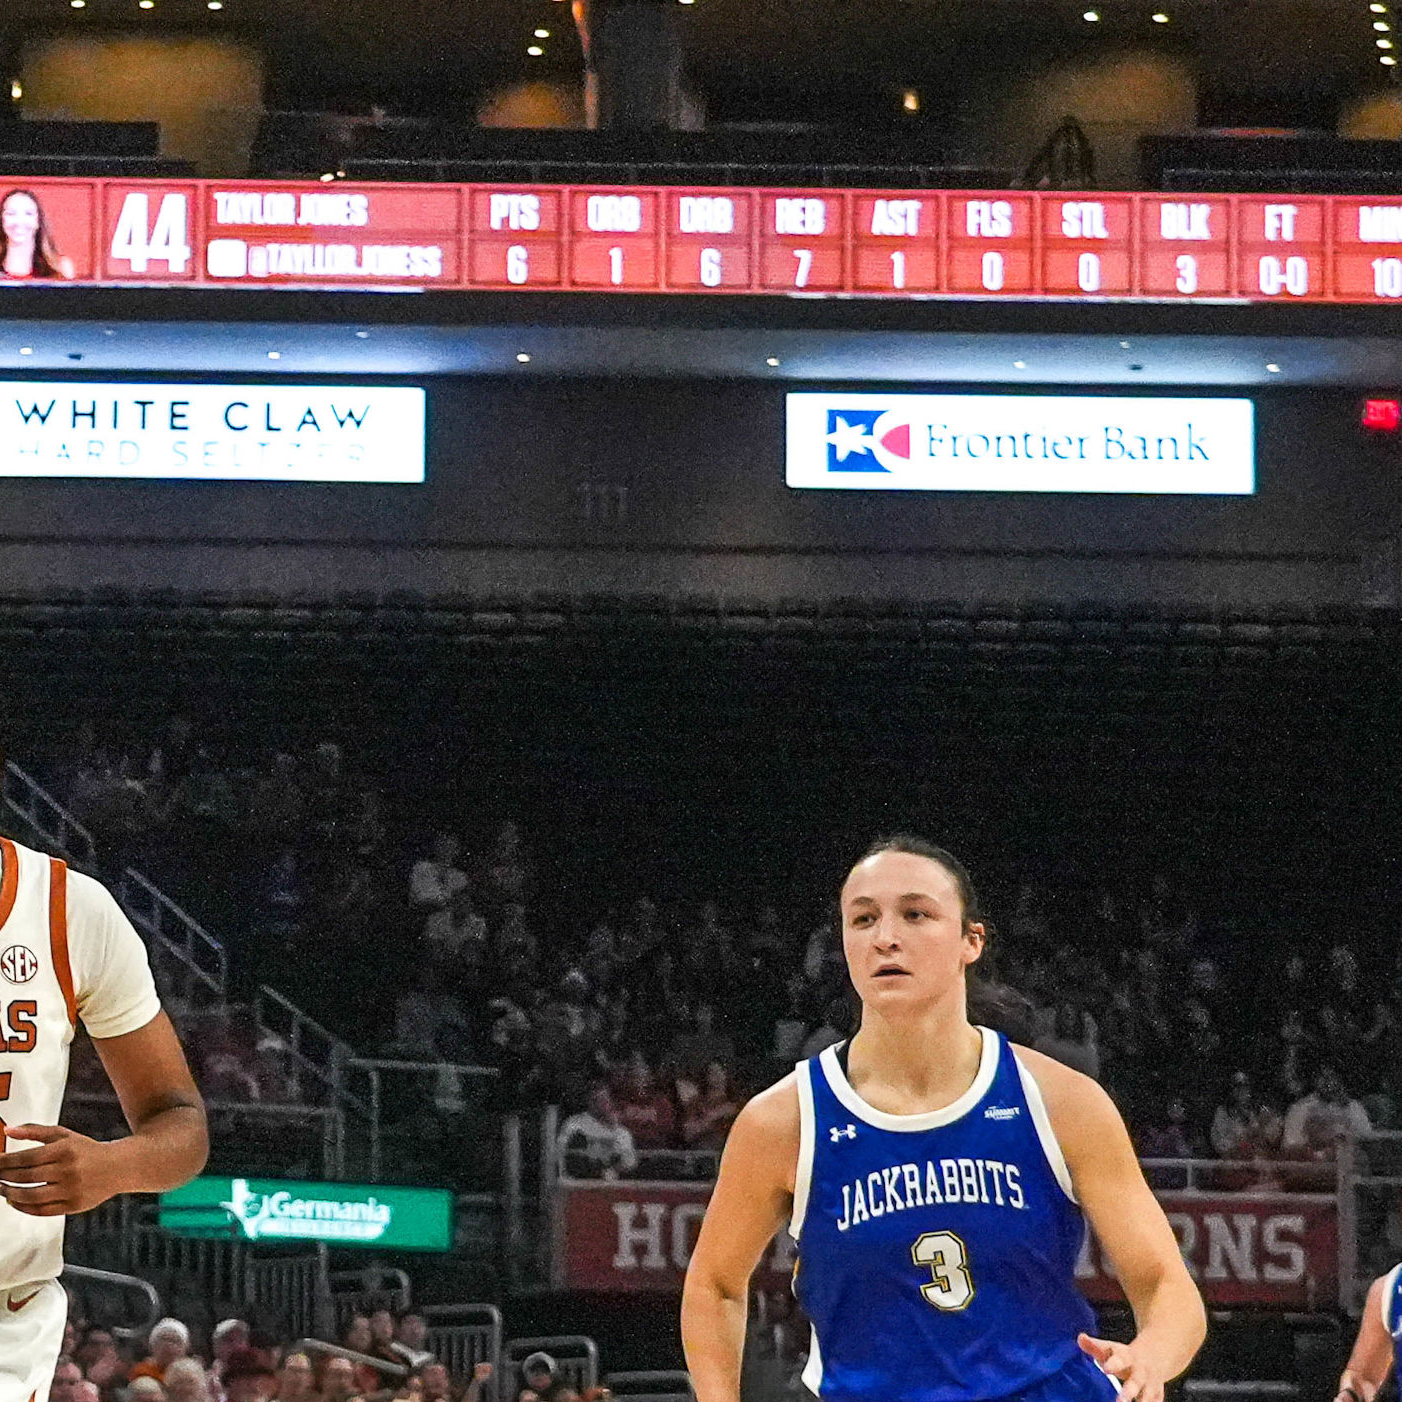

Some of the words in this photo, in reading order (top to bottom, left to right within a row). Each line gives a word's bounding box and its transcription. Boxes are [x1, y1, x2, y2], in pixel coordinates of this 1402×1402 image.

[111, 192, 191, 274] 44
[489, 193, 540, 231] PTS
[774, 198, 826, 235] REB
[870, 199, 922, 237] AST
[965, 200, 1013, 238] FLS
[1060, 201, 1109, 239] STL
[1159, 202, 1212, 241] BLK
[1264, 204, 1297, 242] FT
[506, 244, 528, 285] 6
[608, 246, 624, 285] 1
[699, 247, 722, 287] 6
[792, 248, 813, 288] 7
[889, 250, 905, 289] 1
[981, 251, 1004, 291] 0
[1078, 252, 1101, 292] 0
[1175, 254, 1197, 295] 3
[1258, 256, 1309, 297] 0-0
[15, 399, 191, 432] WHITE
[223, 401, 371, 433] CLAW
[927, 421, 1090, 462] Frontier
[1103, 425, 1211, 463] Bank
[2, 953, 36, 979] SEC
[836, 1157, 1025, 1232] JACKRABBITS
[910, 1230, 976, 1312] 3
